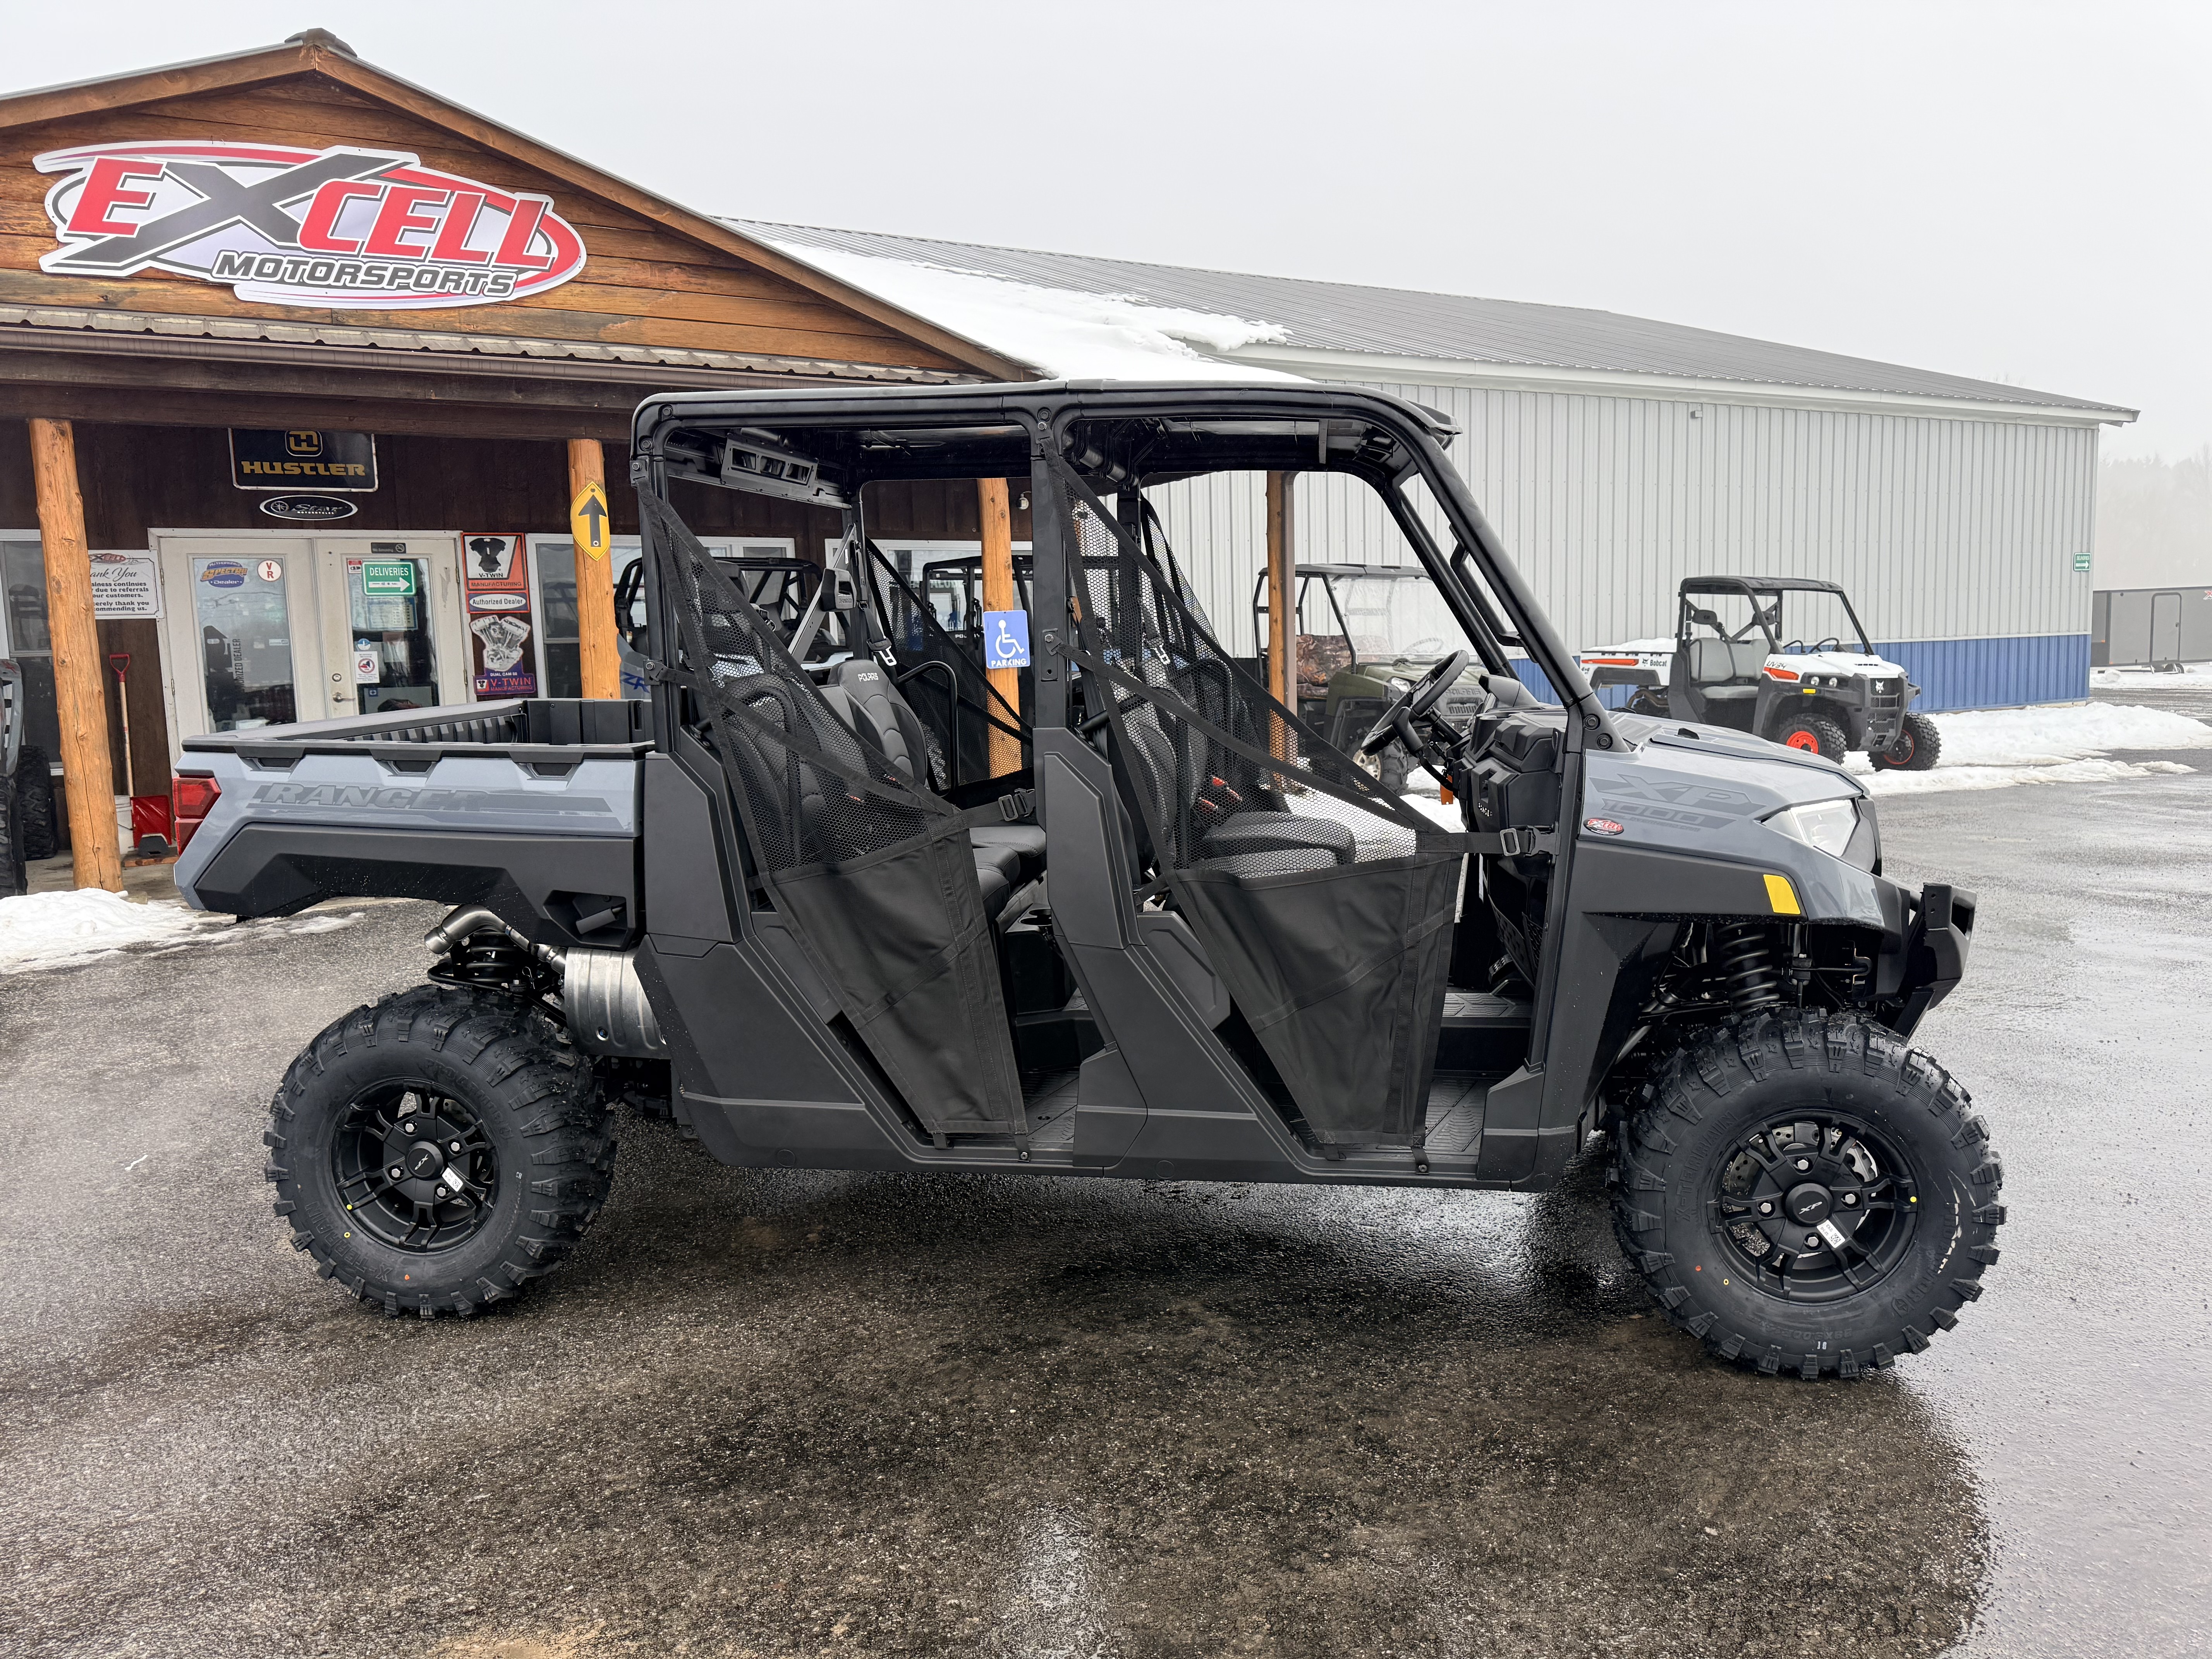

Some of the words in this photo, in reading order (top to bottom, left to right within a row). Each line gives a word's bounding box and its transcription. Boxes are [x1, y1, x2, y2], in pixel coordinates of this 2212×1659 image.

[59, 153, 554, 267] EXCELL
[213, 251, 517, 297] MOTORSPORTS
[241, 461, 365, 476] HUSTLER
[90, 568, 110, 579] ank
[112, 567, 137, 582] You
[370, 567, 409, 576] DELIVERIES
[232, 639, 242, 661] DEALER
[991, 658, 1027, 667] PARKING
[1766, 661, 1787, 669] UV34
[858, 672, 879, 682] POLARIS
[1598, 773, 1753, 805] XP
[261, 782, 488, 812] RANGER
[1601, 798, 1705, 826] 1000
[1799, 1202, 1822, 1214] XP
